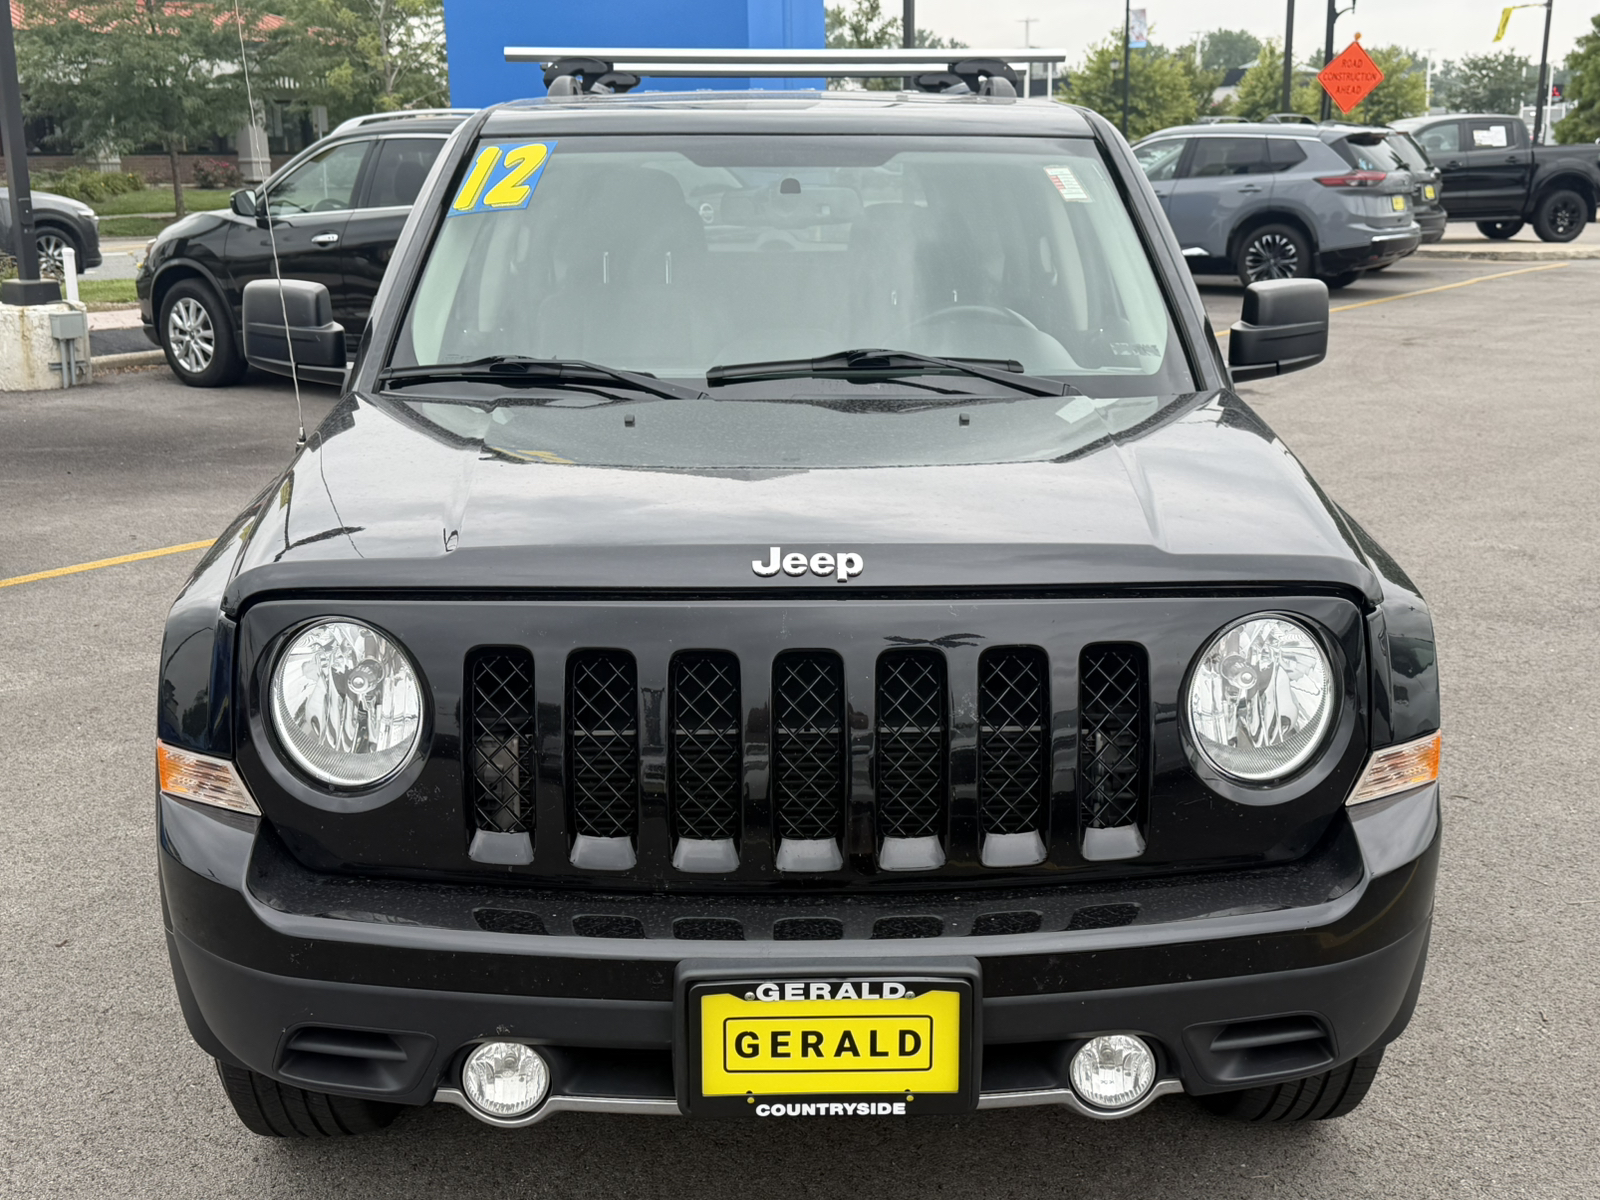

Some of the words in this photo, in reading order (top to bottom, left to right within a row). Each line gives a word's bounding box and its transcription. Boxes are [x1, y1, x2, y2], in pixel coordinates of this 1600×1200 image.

[1341, 58, 1363, 68] ROAD
[1322, 71, 1377, 82] CONSTRUCTION
[1335, 85, 1362, 95] AHEAD
[453, 143, 548, 210] 12
[751, 546, 864, 583] Jeep
[755, 982, 906, 1002] GERALD
[734, 1029, 922, 1059] GERALD
[755, 1102, 906, 1117] COUNTRYSIDE
